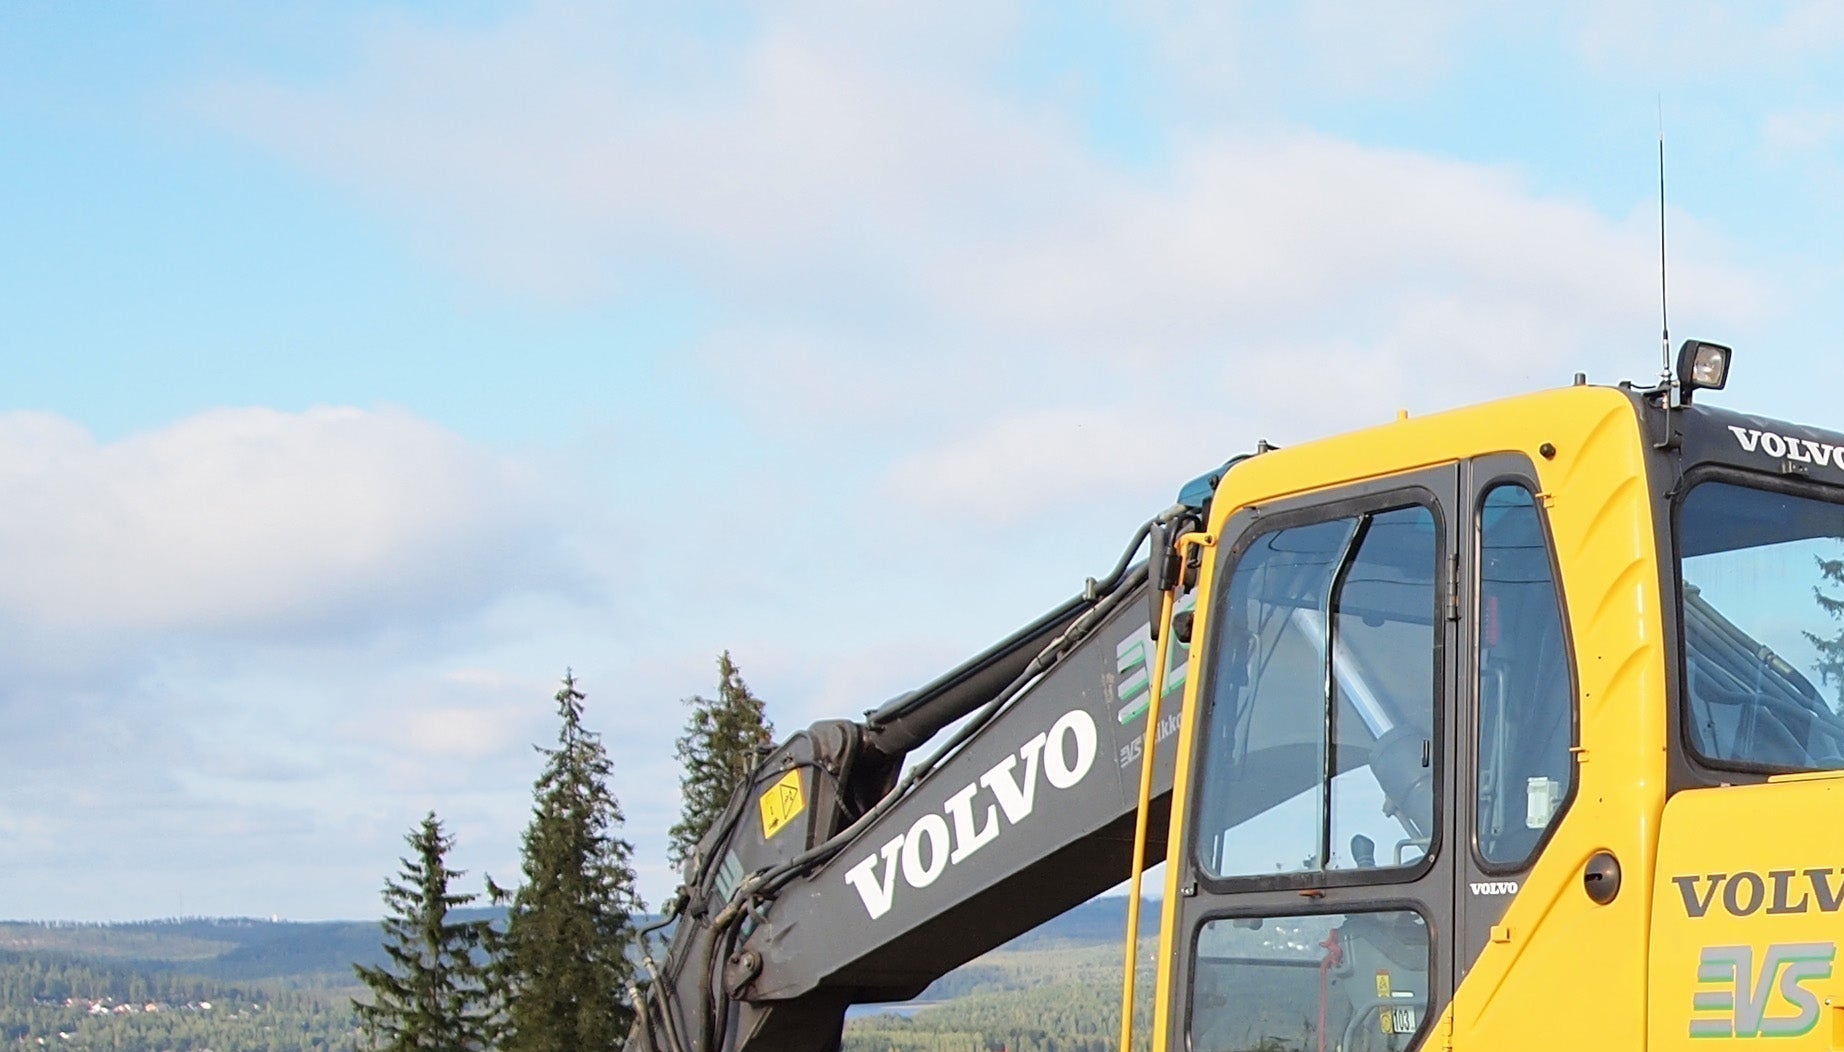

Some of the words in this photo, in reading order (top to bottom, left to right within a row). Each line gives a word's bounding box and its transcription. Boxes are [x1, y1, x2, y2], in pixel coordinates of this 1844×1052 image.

[844, 709, 1098, 920] VOLVO
[1469, 882, 1518, 895] VOLVO
[1688, 942, 1836, 1039] EVS
